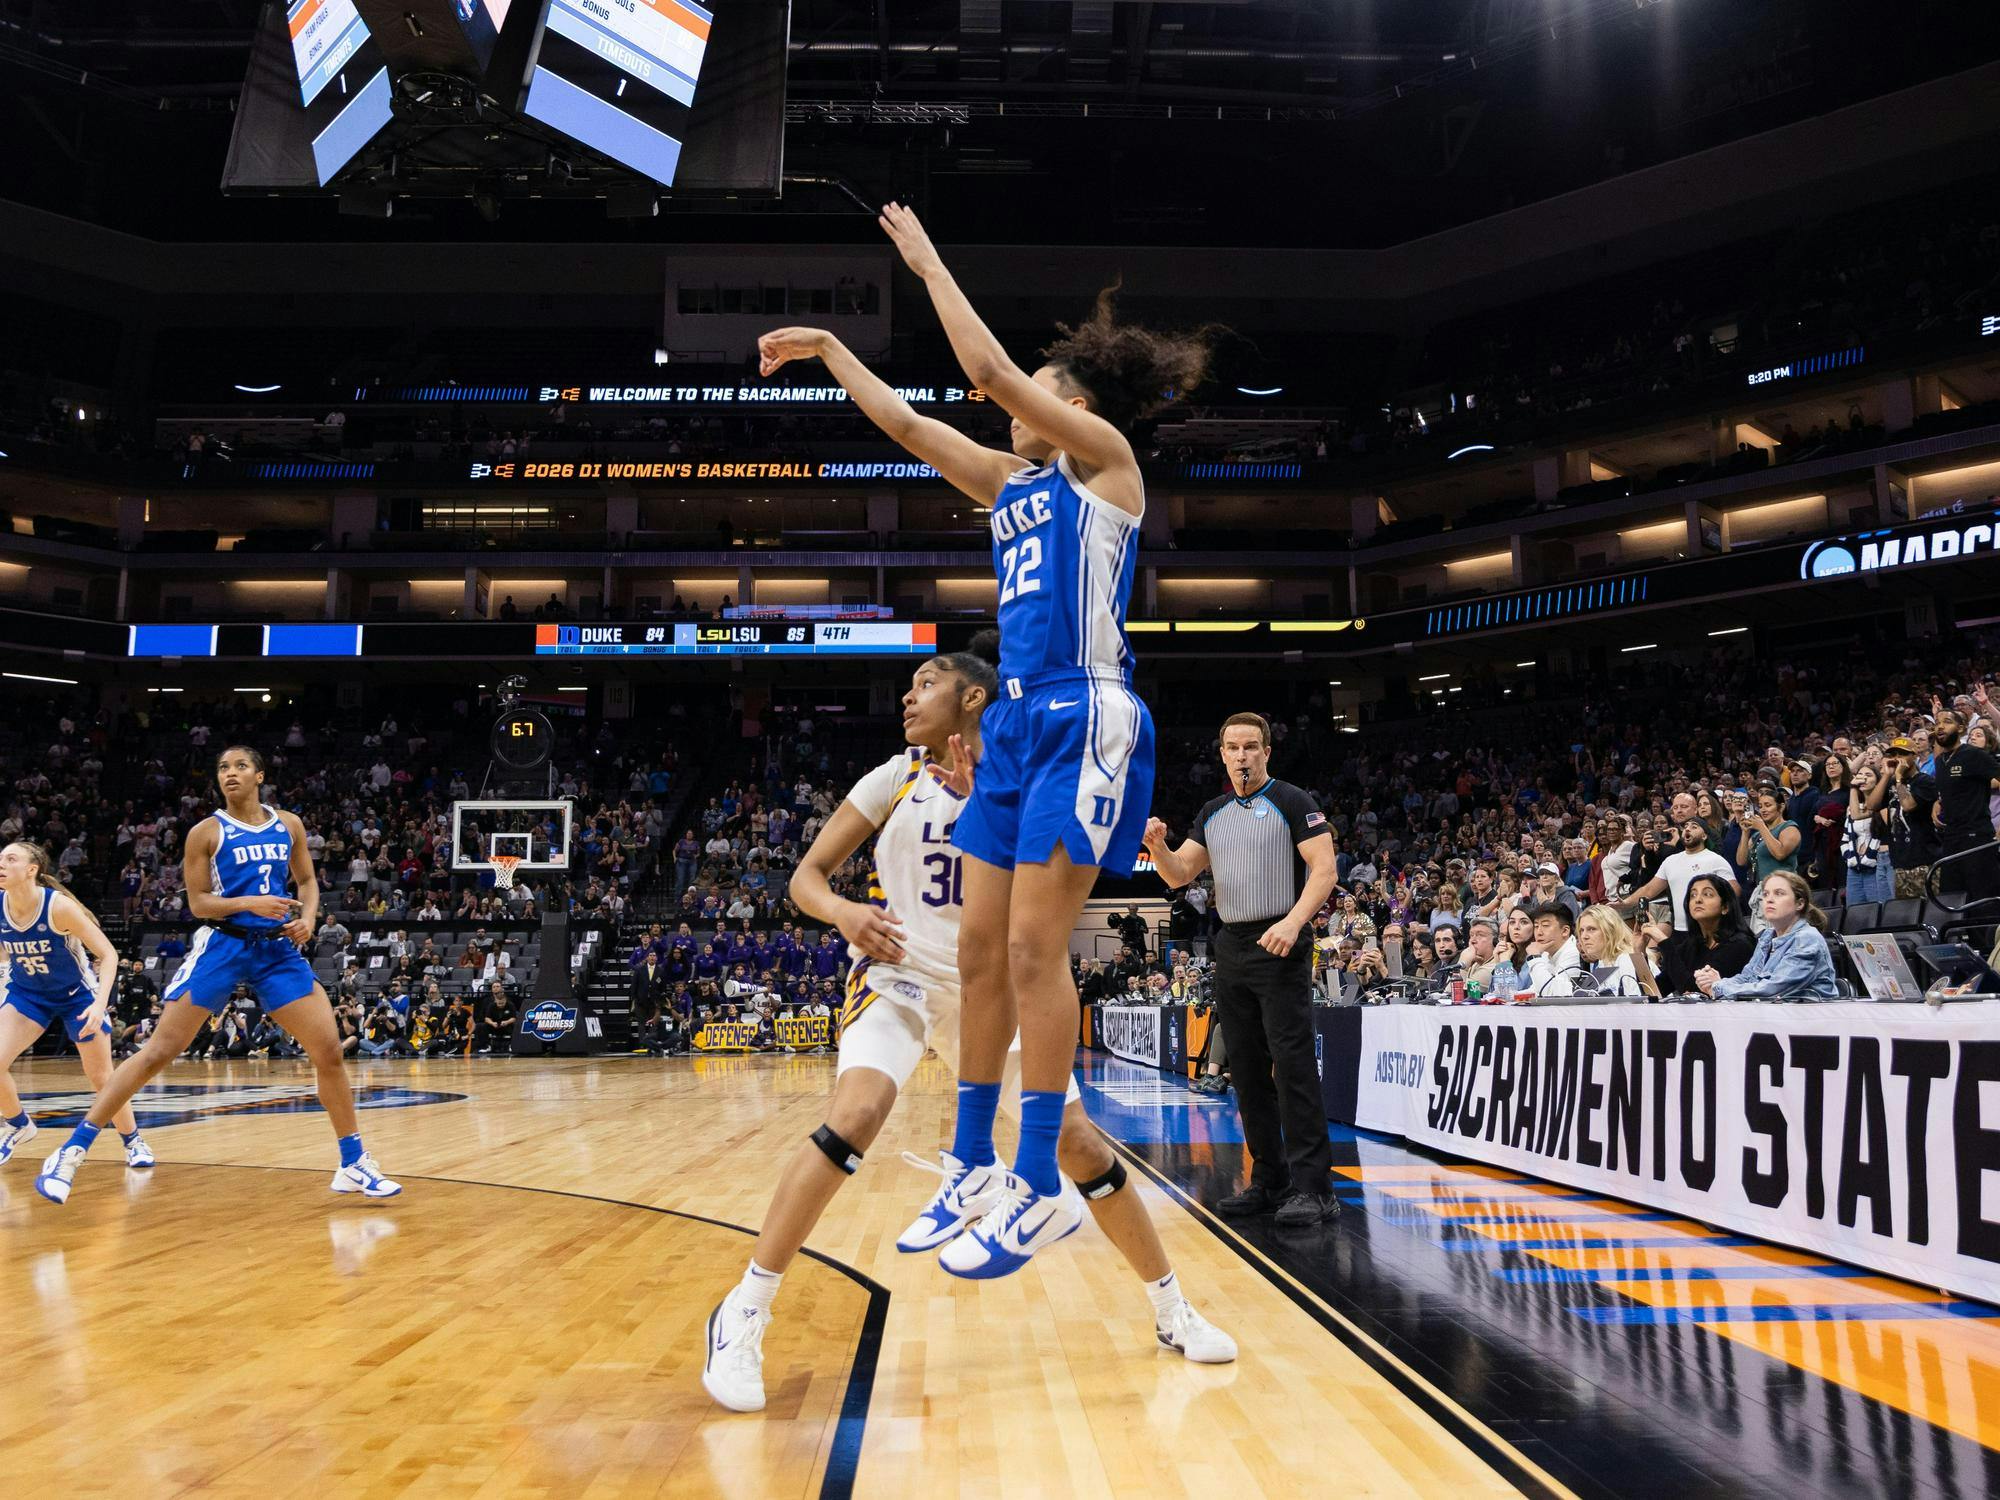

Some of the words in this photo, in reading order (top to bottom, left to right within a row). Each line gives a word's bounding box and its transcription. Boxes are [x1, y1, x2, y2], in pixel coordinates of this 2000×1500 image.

[582, 0, 610, 20] BONUS
[615, 0, 635, 13] OULS
[323, 36, 353, 77] TIMEOUTS
[598, 36, 651, 77] TIMEOUTS
[617, 79, 627, 96] 1
[1748, 370, 1772, 385] 9:20
[1773, 366, 1790, 379] PM
[589, 388, 672, 401] WELCOME
[676, 388, 697, 401] TO
[702, 388, 734, 401] THE
[738, 388, 847, 401] SACRAMENTO
[524, 463, 574, 478] 2026
[579, 463, 602, 478] DI
[607, 463, 692, 478] WOMEN'S
[697, 463, 812, 478] BASKETBALL
[818, 463, 942, 478] CHAMPIONSH
[1860, 524, 2000, 571] MARC
[1000, 536, 1042, 606] 22
[582, 628, 622, 642] DUKE
[646, 627, 665, 642] 84
[697, 629, 731, 641] LSU
[732, 627, 760, 642] LSU
[787, 627, 805, 642] 85
[822, 627, 850, 640] 4TH
[512, 723, 533, 736] 6.7
[233, 844, 288, 864] DUKE
[258, 864, 272, 894] 3
[16, 956, 50, 976] 35
[534, 1011, 562, 1020] MARCH
[537, 1019, 575, 1028] MADNESS
[777, 1019, 828, 1044] DEFENSE
[1408, 1054, 1425, 1088] BY
[1428, 1024, 1717, 1192] SACRAMENTO
[1742, 1032, 2000, 1264] STATE
